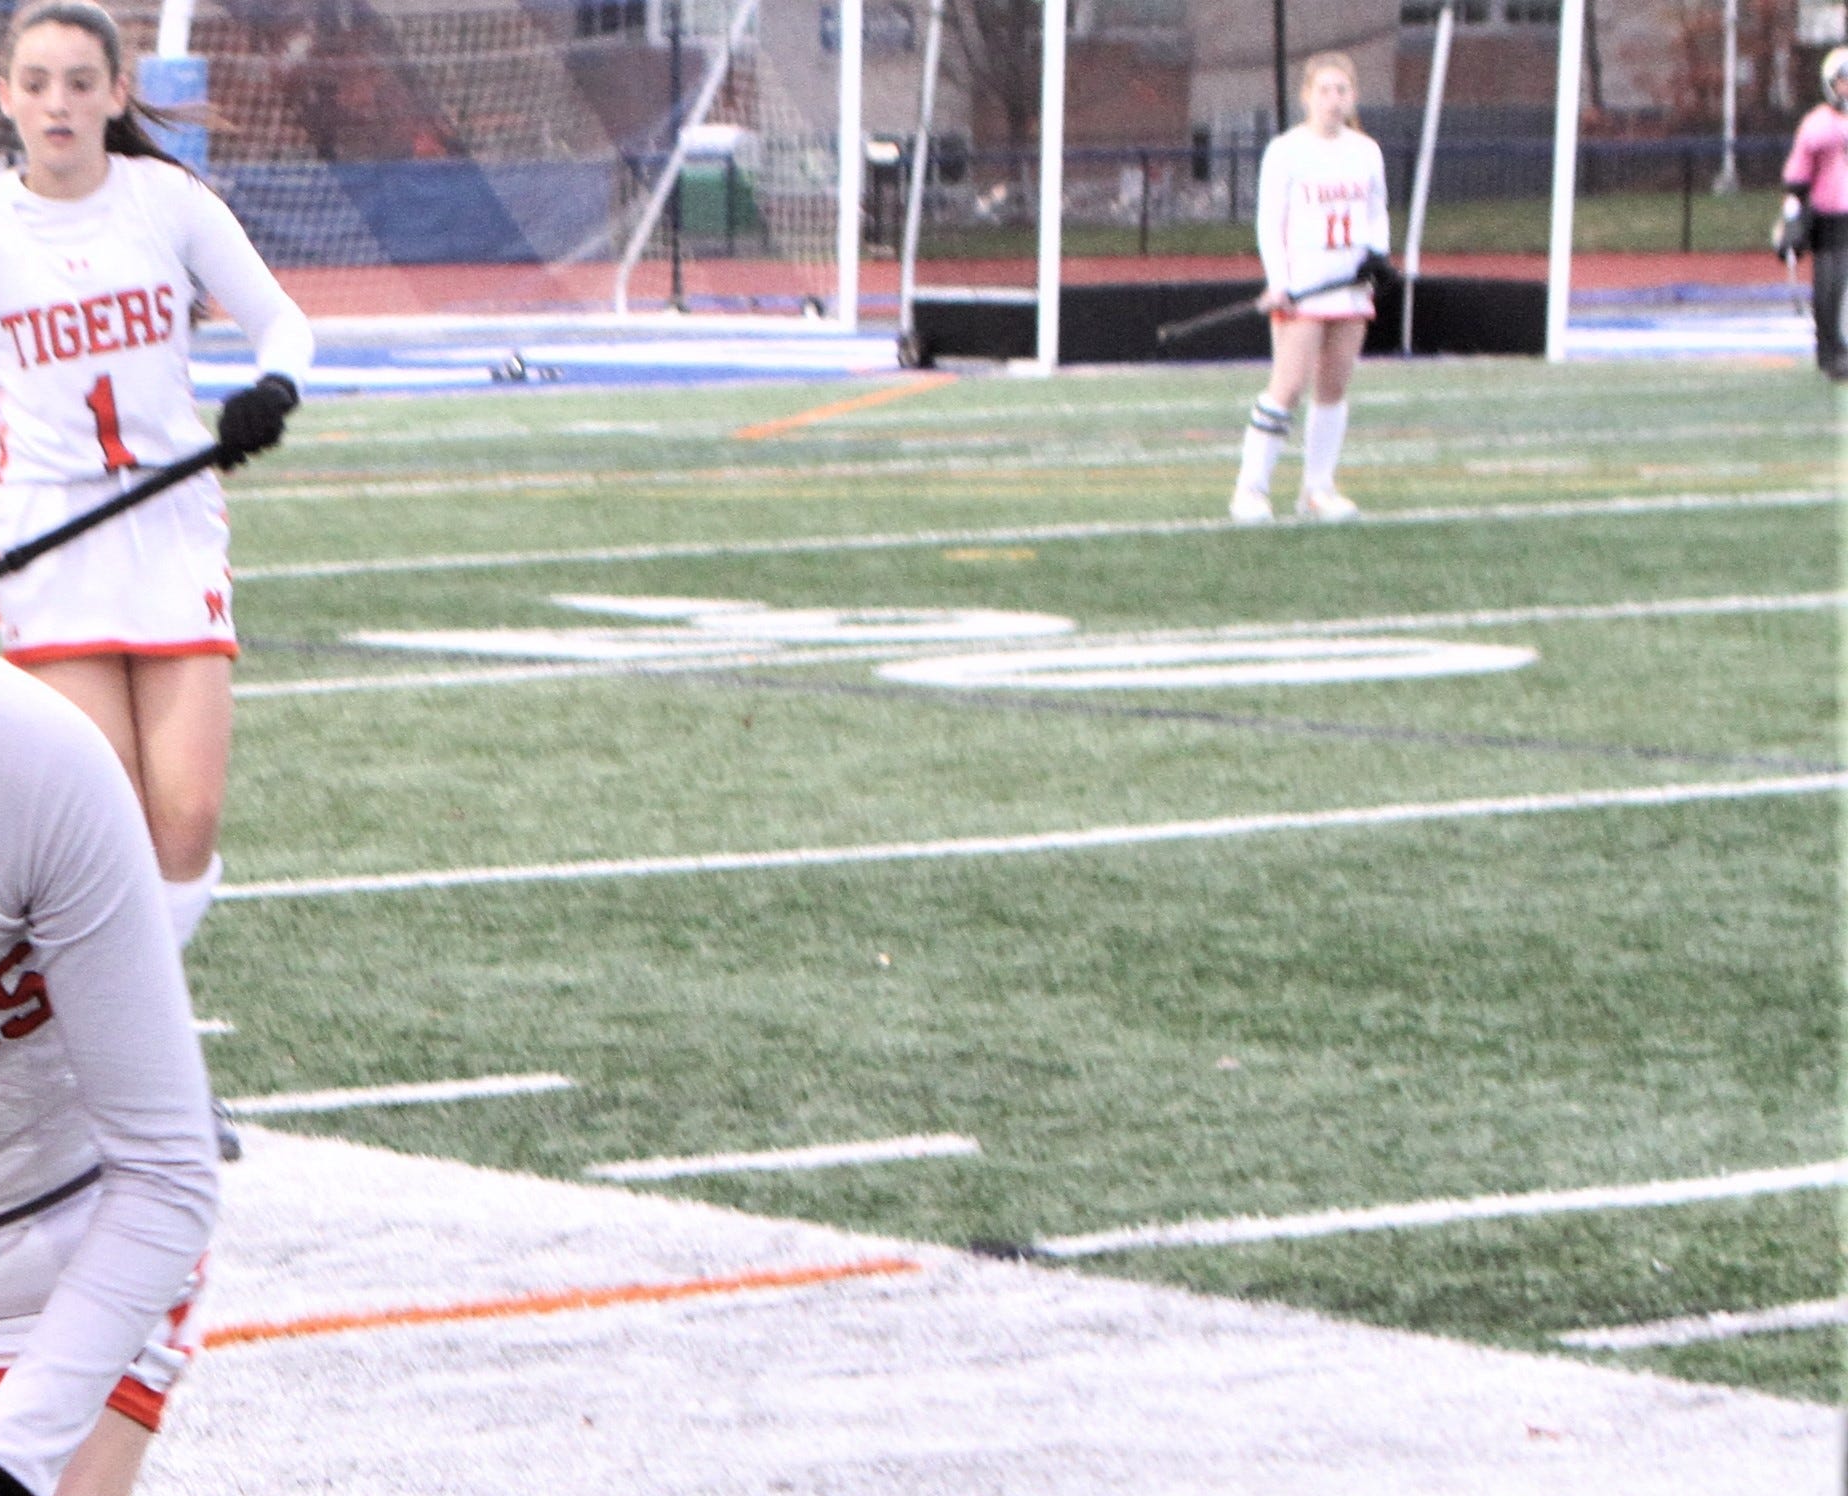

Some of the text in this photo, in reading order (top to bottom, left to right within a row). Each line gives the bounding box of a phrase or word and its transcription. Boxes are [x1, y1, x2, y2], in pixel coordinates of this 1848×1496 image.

[1326, 212, 1352, 250] 11
[0, 284, 174, 370] TIGERS
[84, 374, 140, 476] 1
